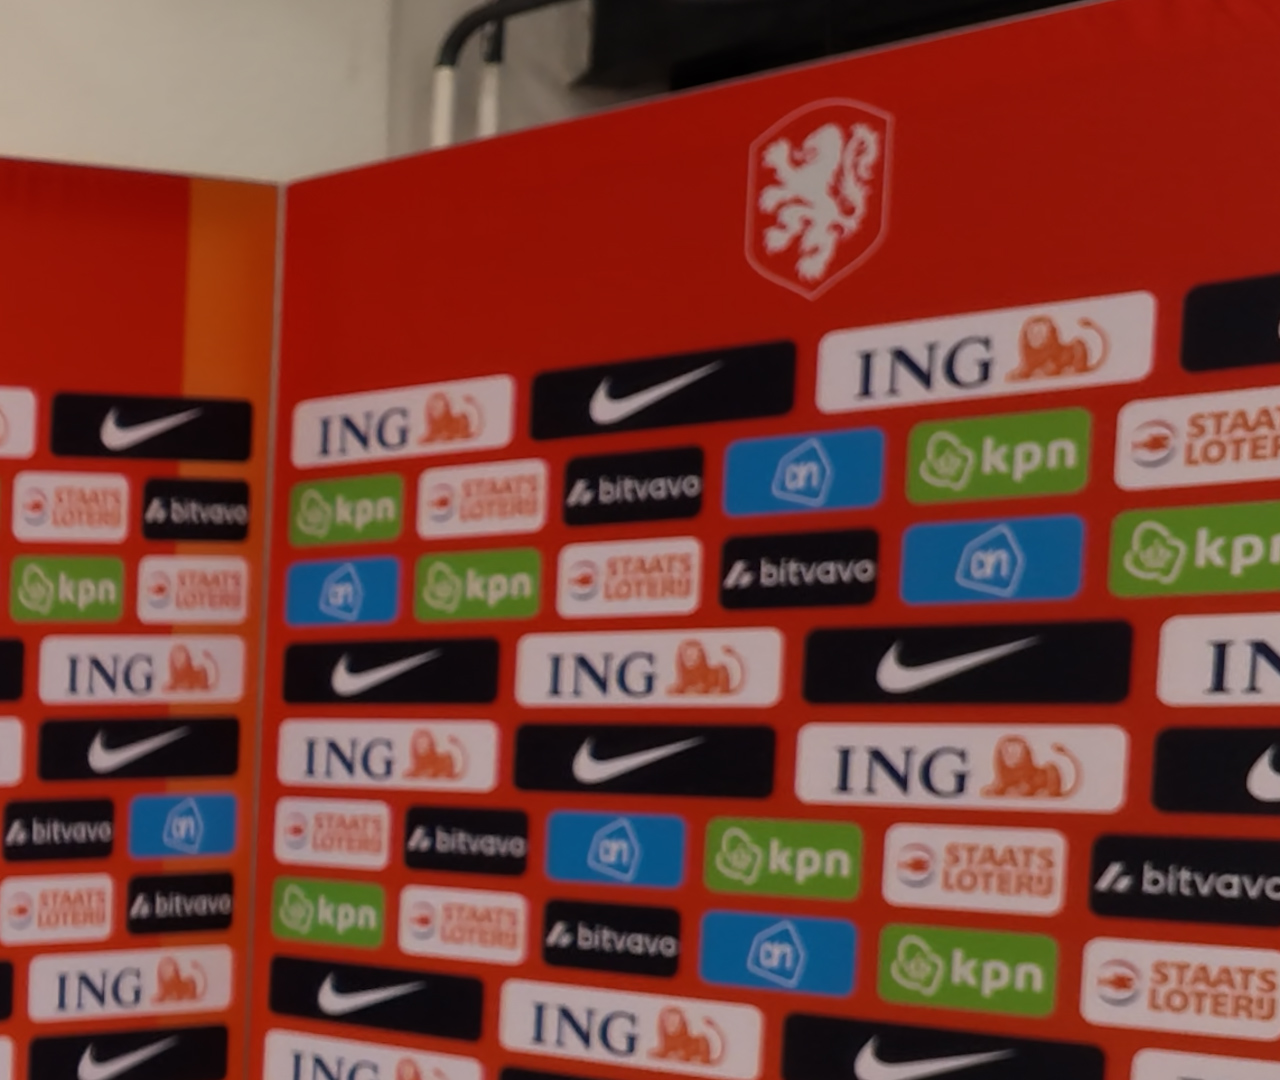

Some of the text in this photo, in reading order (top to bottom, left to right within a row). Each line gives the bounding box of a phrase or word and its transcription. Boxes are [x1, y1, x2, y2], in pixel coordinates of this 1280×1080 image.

[856, 337, 992, 400] ING
[318, 409, 409, 457] ING
[1186, 405, 1280, 438] STAA
[982, 437, 1076, 481] kpn
[599, 475, 701, 503] bitvavo
[171, 498, 247, 524] bitvavo
[335, 492, 396, 531] kpn
[58, 572, 117, 610] kpn
[468, 570, 532, 606] kpn
[760, 559, 874, 586] bitvavo
[66, 655, 153, 695] ING
[548, 652, 657, 699] ING
[306, 738, 393, 780] ING
[835, 745, 970, 799] ING
[32, 819, 111, 844] bitvavo
[436, 828, 526, 857] bitvavo
[769, 839, 851, 883] kpn
[155, 893, 231, 917] bitvavo
[317, 896, 377, 933] kpn
[577, 923, 677, 957] bitvavo
[58, 968, 140, 1011] ING
[951, 949, 1043, 997] kpn
[533, 1001, 638, 1055] ING
